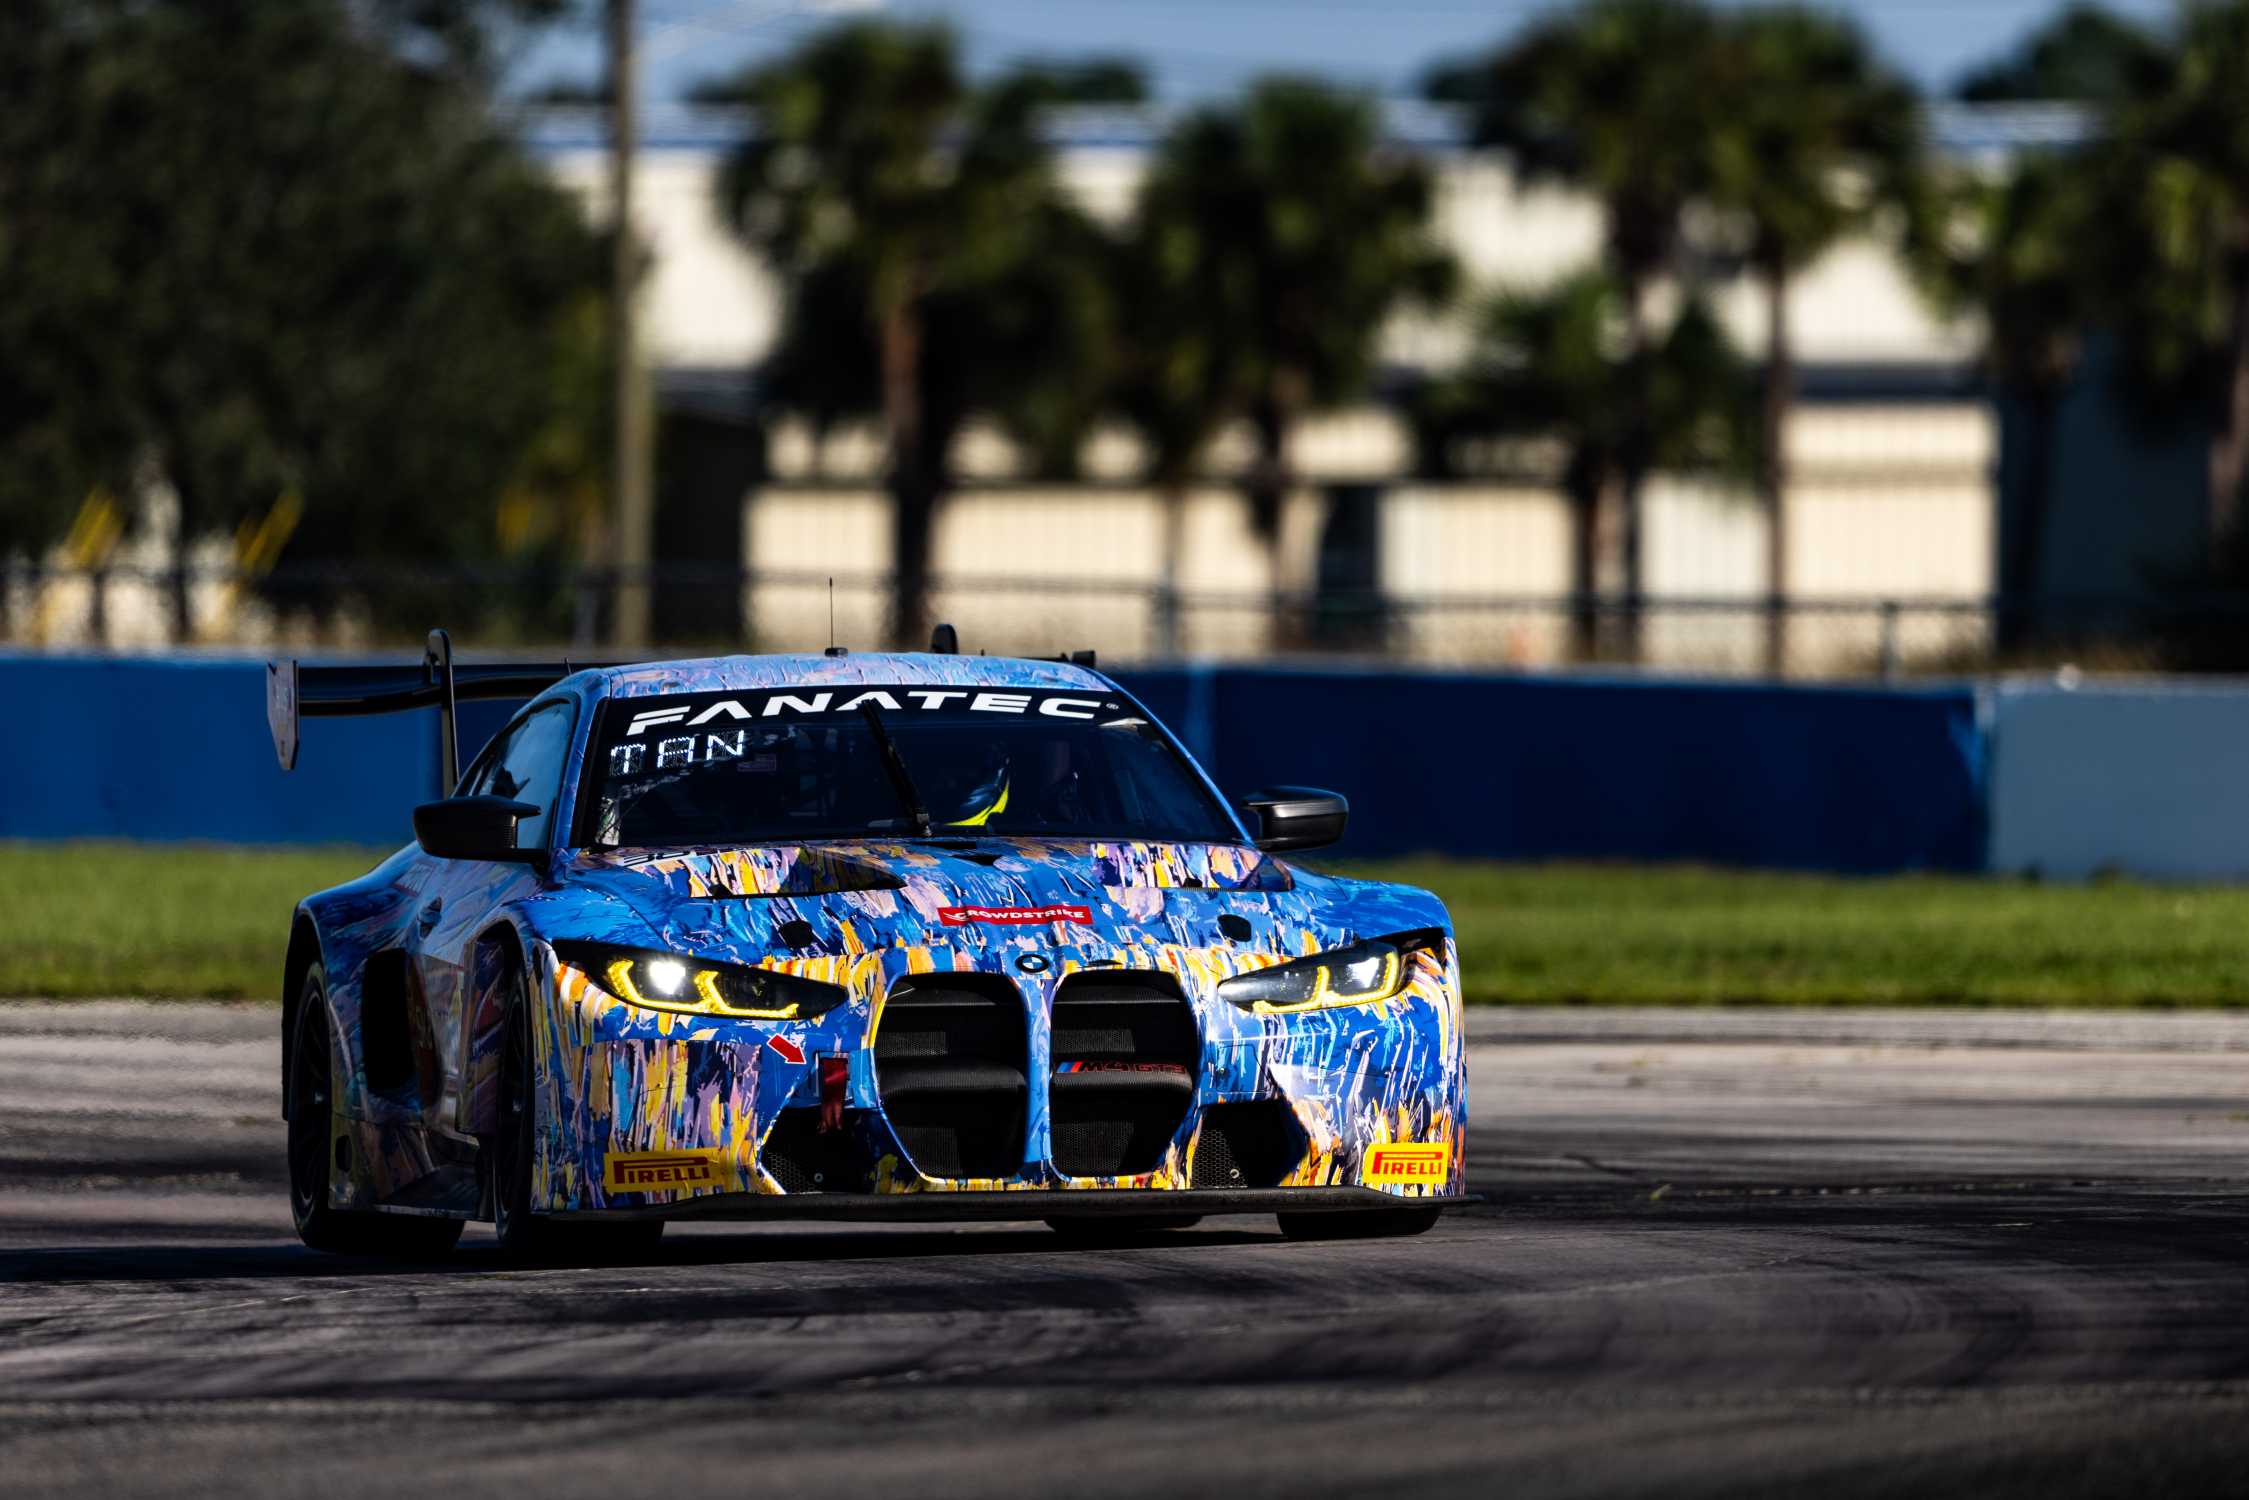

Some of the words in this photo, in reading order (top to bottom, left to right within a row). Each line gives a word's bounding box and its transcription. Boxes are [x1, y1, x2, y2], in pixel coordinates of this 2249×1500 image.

[626, 691, 1102, 736] FANATEC
[610, 729, 744, 774] TAN
[945, 908, 1086, 922] CROWDSTRIKE
[613, 1156, 711, 1185] PIRELLI
[1371, 1151, 1443, 1175] PIRELLI
